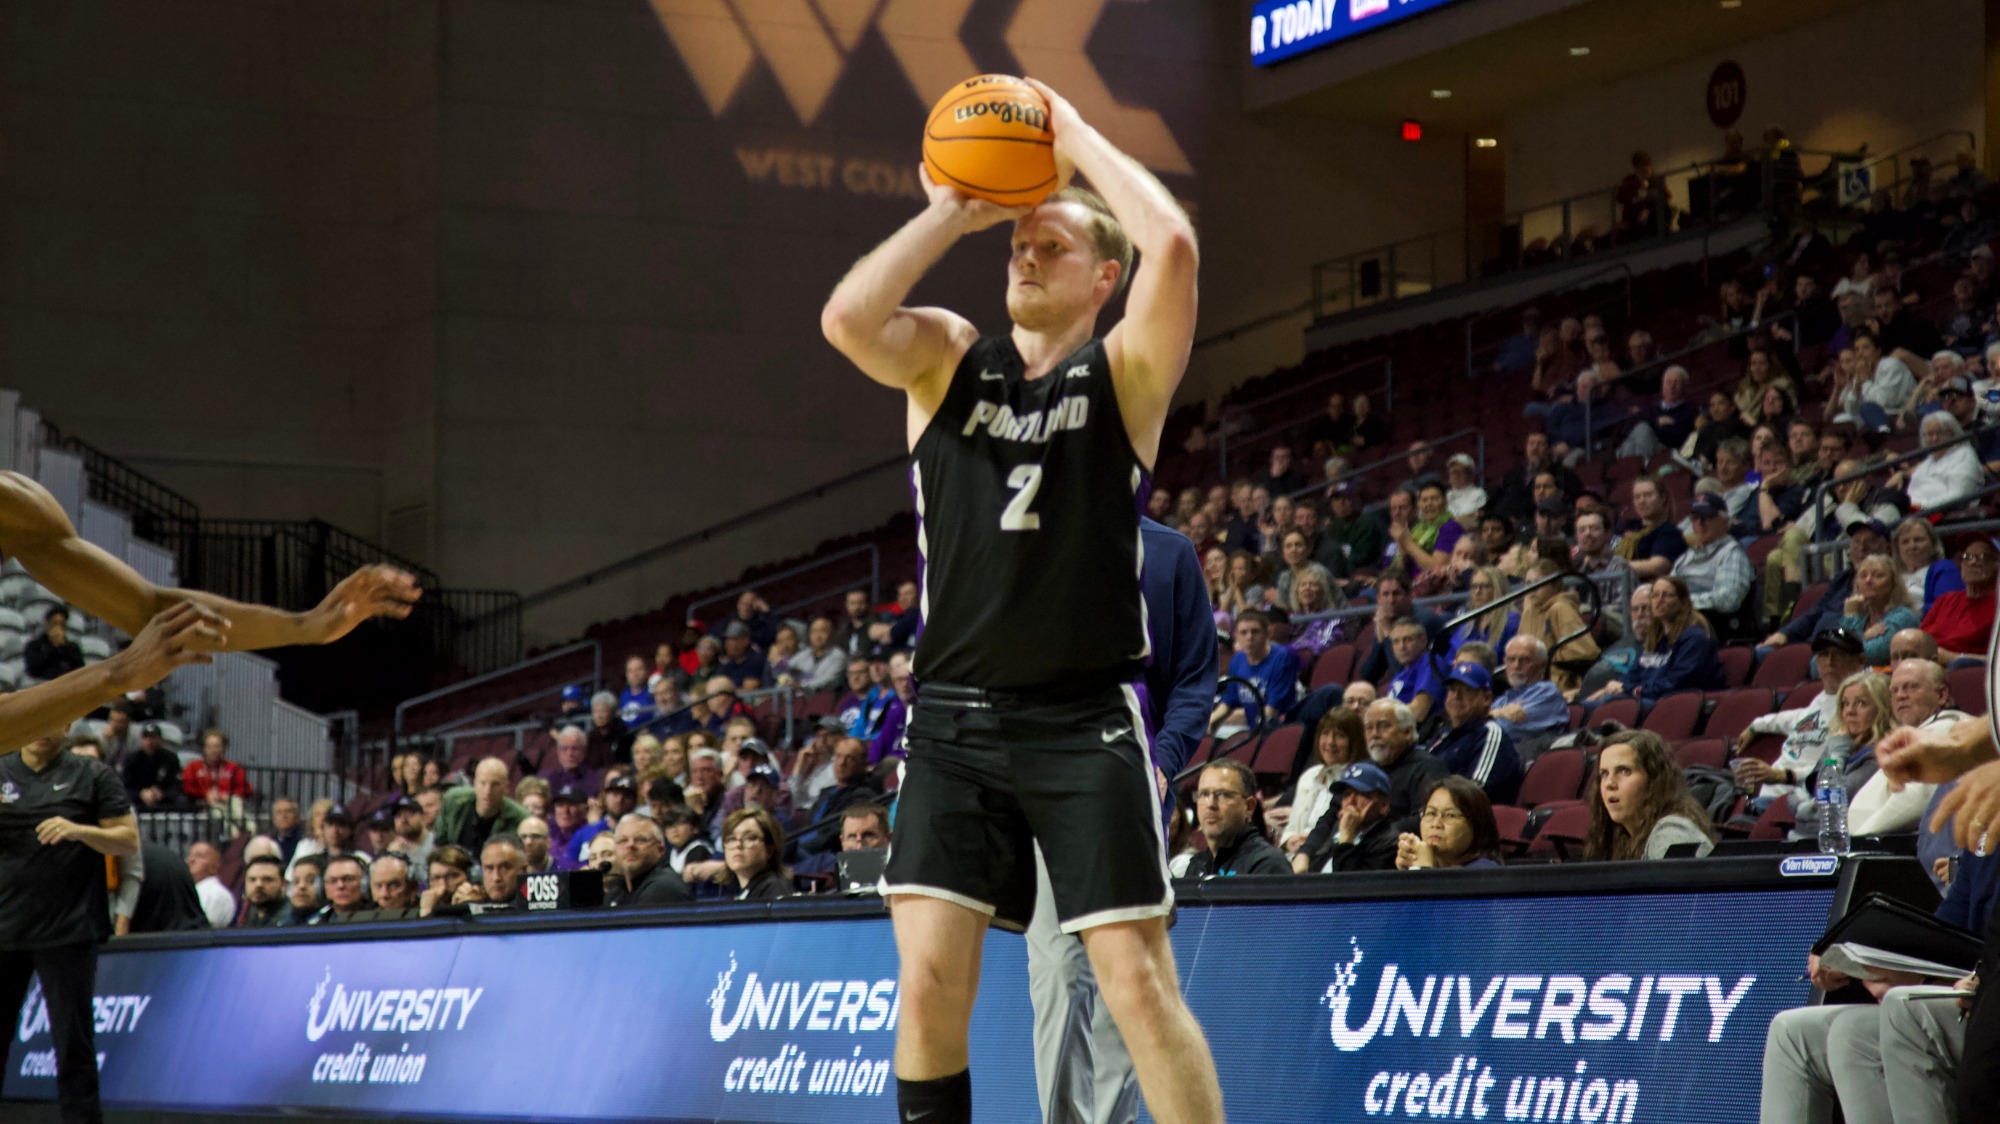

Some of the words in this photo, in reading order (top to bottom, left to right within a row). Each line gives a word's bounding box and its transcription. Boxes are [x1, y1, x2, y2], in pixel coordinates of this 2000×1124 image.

[1270, 0, 1336, 49] TODAY
[954, 101, 1049, 133] Wilson
[735, 147, 834, 188] WEST
[1000, 463, 1043, 531] 2
[526, 874, 559, 902] POSS
[1786, 860, 1801, 871] Van
[1801, 860, 1834, 873] Wagner
[306, 983, 484, 1042] UNIVERSITY
[1328, 963, 1757, 1052] UNIVERSITY
[312, 1041, 371, 1084] credit
[368, 1042, 427, 1084] union
[724, 1042, 806, 1094] credit
[807, 1045, 890, 1096] union
[1364, 1054, 1496, 1120] credit
[1504, 1059, 1640, 1124] union
